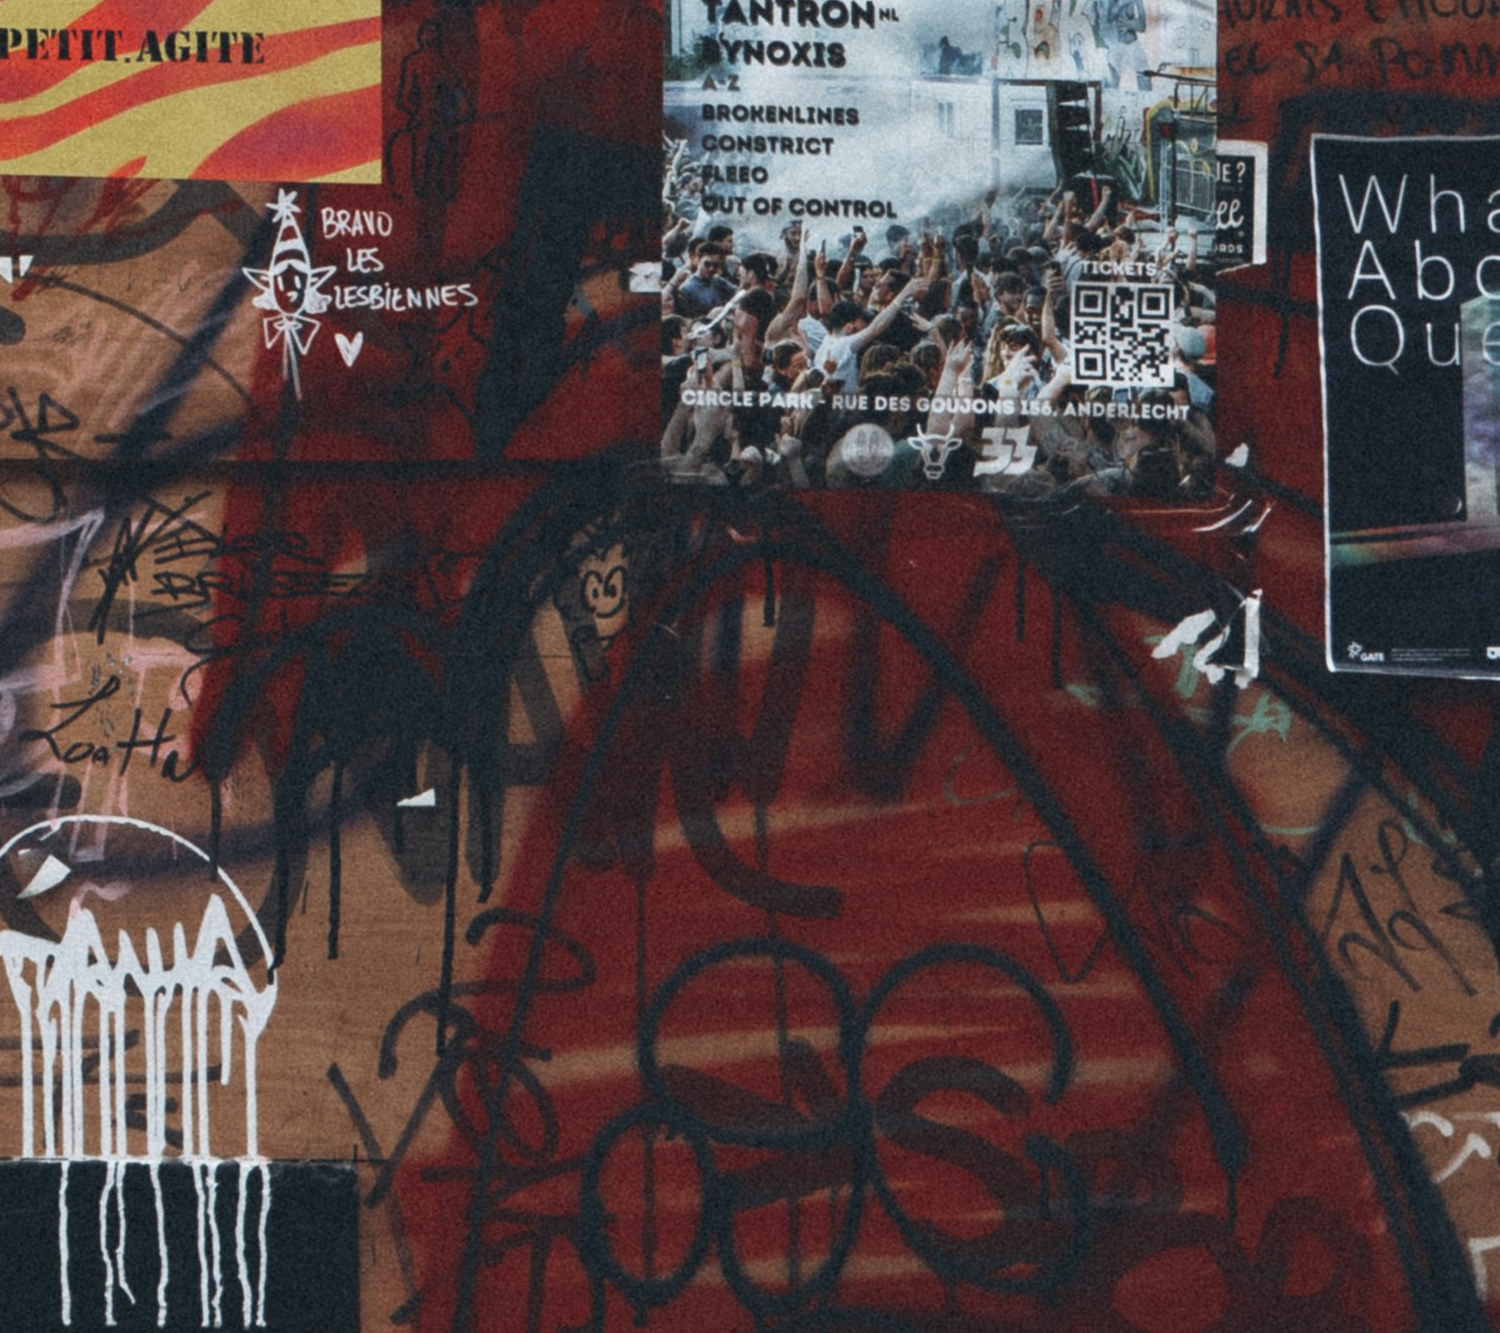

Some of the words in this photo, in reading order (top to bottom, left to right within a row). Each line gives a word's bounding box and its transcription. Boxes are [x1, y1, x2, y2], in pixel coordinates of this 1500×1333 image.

[879, 8, 899, 23] NL
[700, 38, 846, 69] SYNOXIS
[701, 103, 859, 126] BROKENLINES
[701, 133, 835, 156] CONSTRICT
[701, 164, 769, 185] FLEEO
[701, 194, 746, 215] OUT
[752, 197, 786, 216] OF
[789, 197, 898, 219] CONTROL
[320, 207, 394, 240] BRAVO
[345, 248, 385, 276] LES
[1080, 260, 1158, 277] TICKETS
[681, 389, 754, 408] CIRCLE
[759, 391, 813, 409] PARK
[832, 394, 870, 411] RUE
[875, 395, 911, 413] DES
[916, 397, 1015, 416] GOUJONS
[1064, 401, 1190, 421] ANDERLECHT
